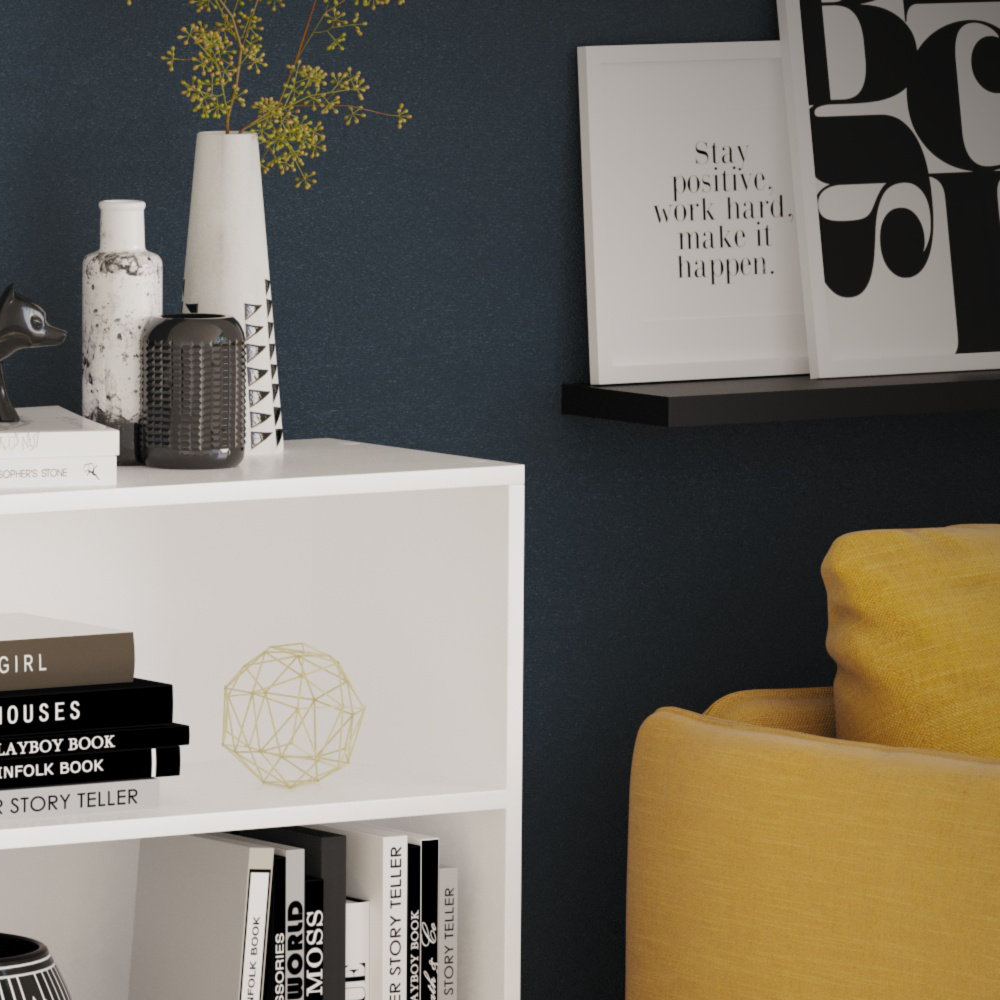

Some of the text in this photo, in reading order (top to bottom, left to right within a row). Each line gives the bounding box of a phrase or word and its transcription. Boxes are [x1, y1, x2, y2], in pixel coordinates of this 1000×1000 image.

[695, 141, 749, 171] Stay
[654, 197, 715, 223] work
[679, 220, 772, 250] make it
[678, 255, 775, 285] happen.
[41, 468, 67, 478] STONE
[67, 734, 116, 751] BOOK
[59, 758, 105, 775] BOOK
[10, 793, 71, 814] STORY
[77, 789, 139, 808] TELLER
[389, 846, 402, 909] TELLER
[410, 909, 420, 950] BOOK
[444, 887, 455, 939] TELLER
[250, 916, 261, 956] BOOK
[286, 900, 303, 1000] WORLD
[305, 909, 324, 997] MOSS
[389, 915, 402, 976] STORY
[444, 945, 454, 996] STORY
